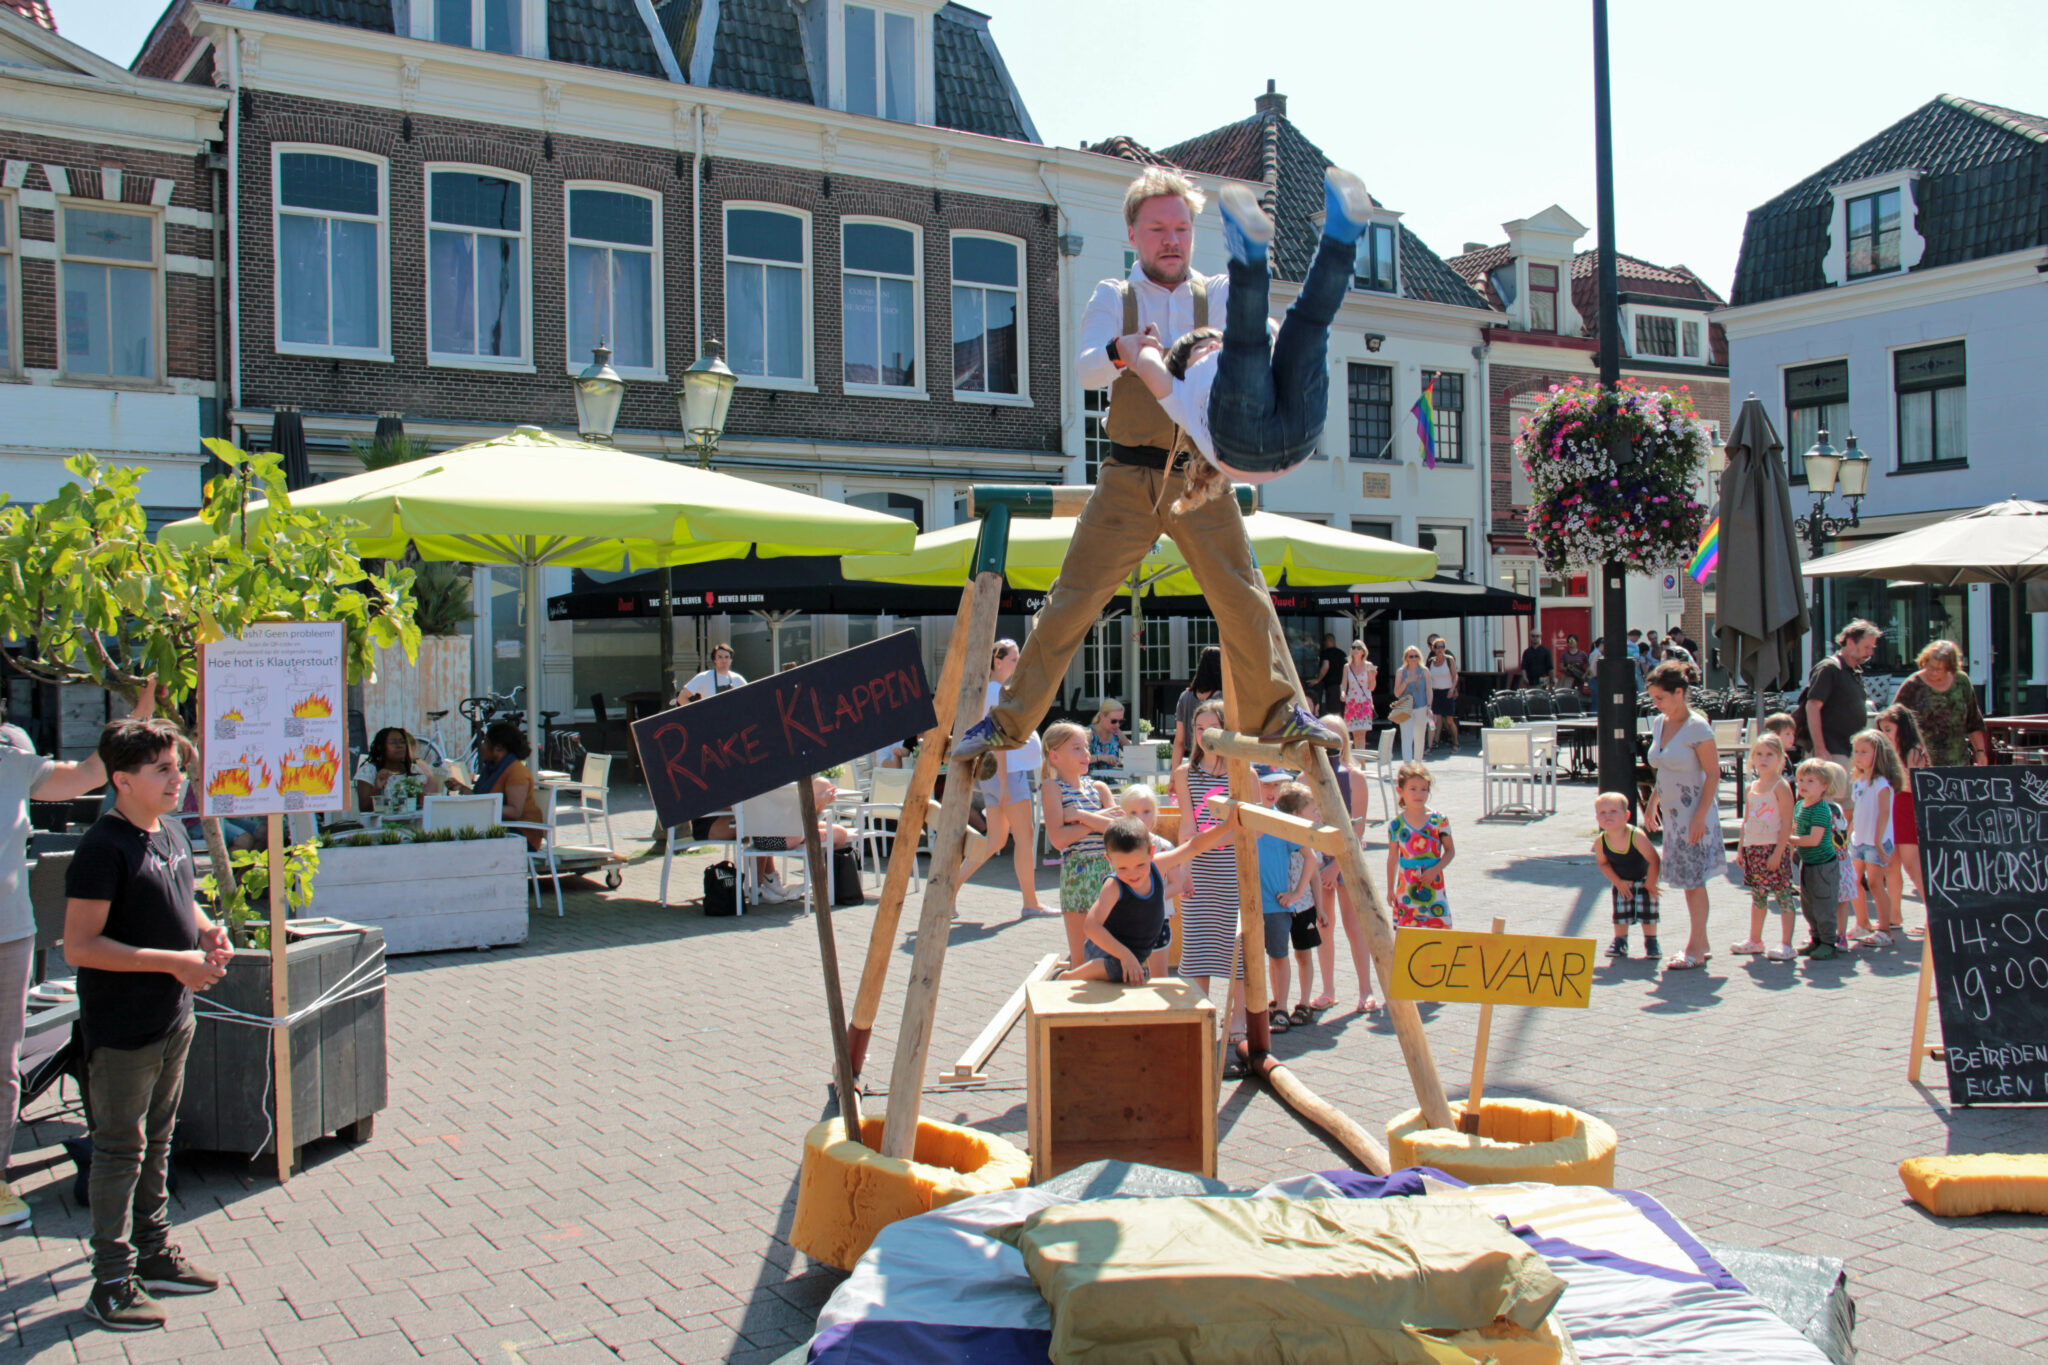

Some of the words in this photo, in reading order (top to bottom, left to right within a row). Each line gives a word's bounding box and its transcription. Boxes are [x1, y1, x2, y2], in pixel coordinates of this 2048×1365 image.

[243, 630, 263, 639] ash?
[264, 629, 289, 639] Geen
[290, 628, 336, 640] probleem!
[208, 658, 231, 669] Hoe
[234, 656, 253, 668] hot
[256, 656, 264, 667] is
[267, 655, 338, 668] Klauterstout?
[653, 722, 769, 800] RAKE
[776, 663, 922, 755] KLAPPEN
[1915, 771, 2013, 802] RAKE
[1408, 941, 1582, 998] GEVAAR
[1966, 1075, 2032, 1097] EIGEN
